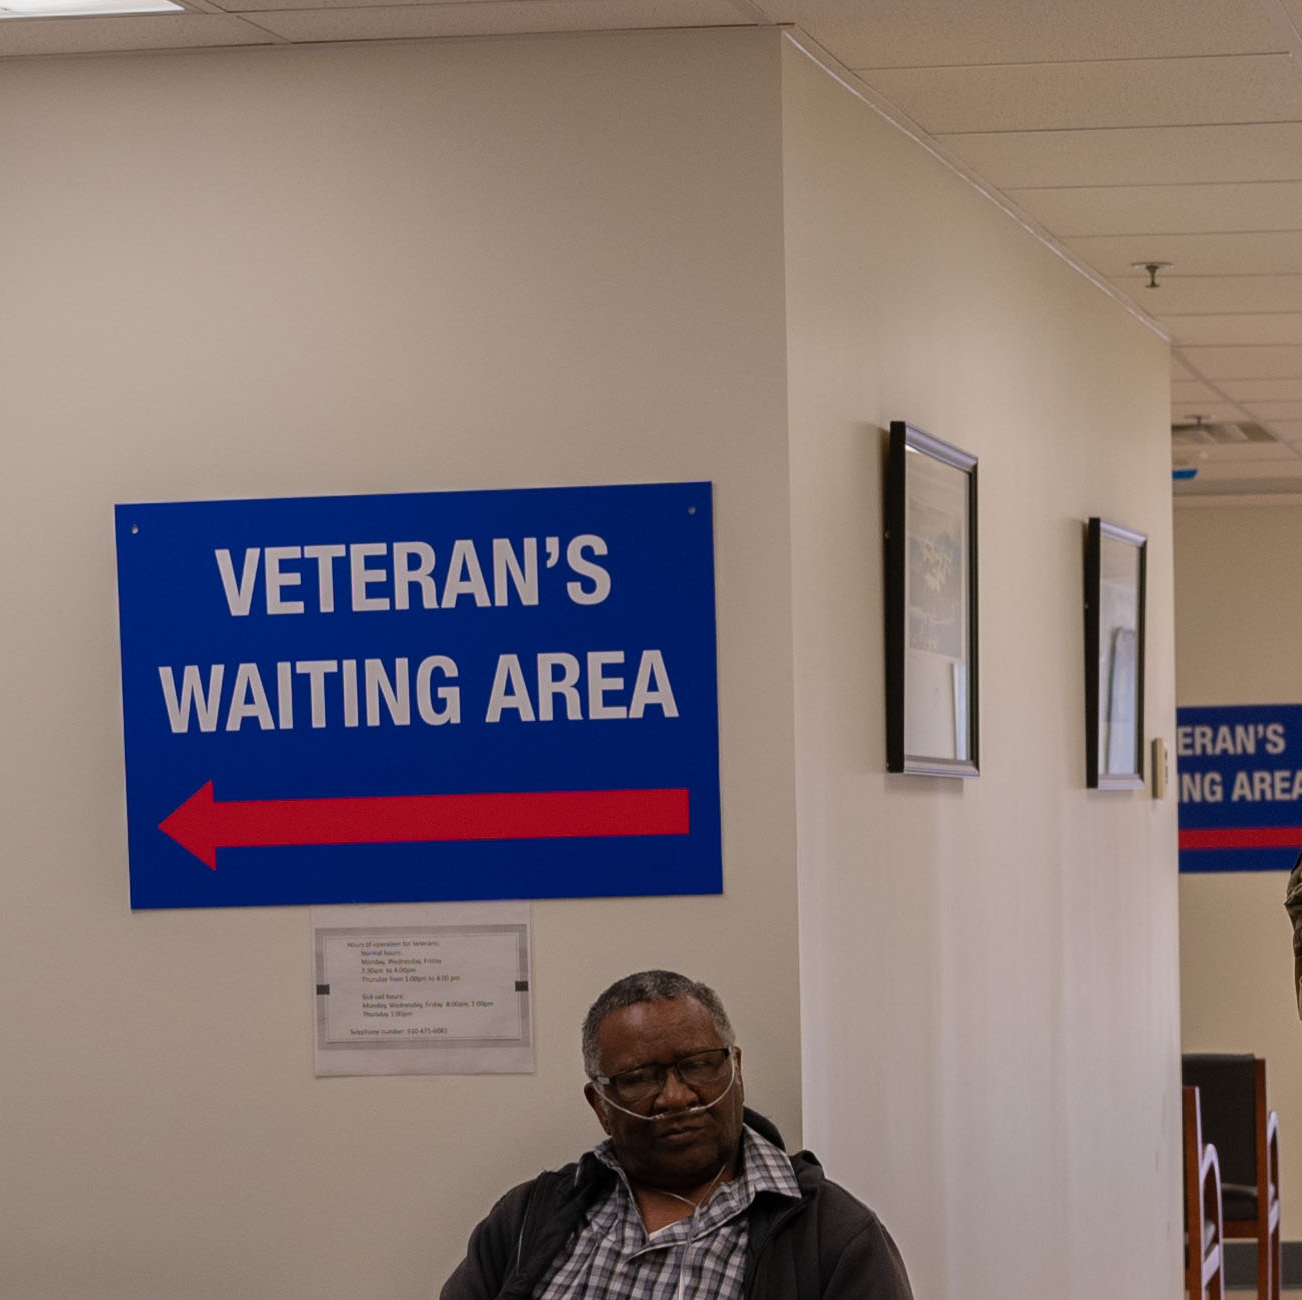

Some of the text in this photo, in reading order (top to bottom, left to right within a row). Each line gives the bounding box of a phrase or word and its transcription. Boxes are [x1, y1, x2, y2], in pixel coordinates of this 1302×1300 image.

[215, 533, 612, 617] VETERAN'S
[158, 649, 680, 734] WAITING AREA
